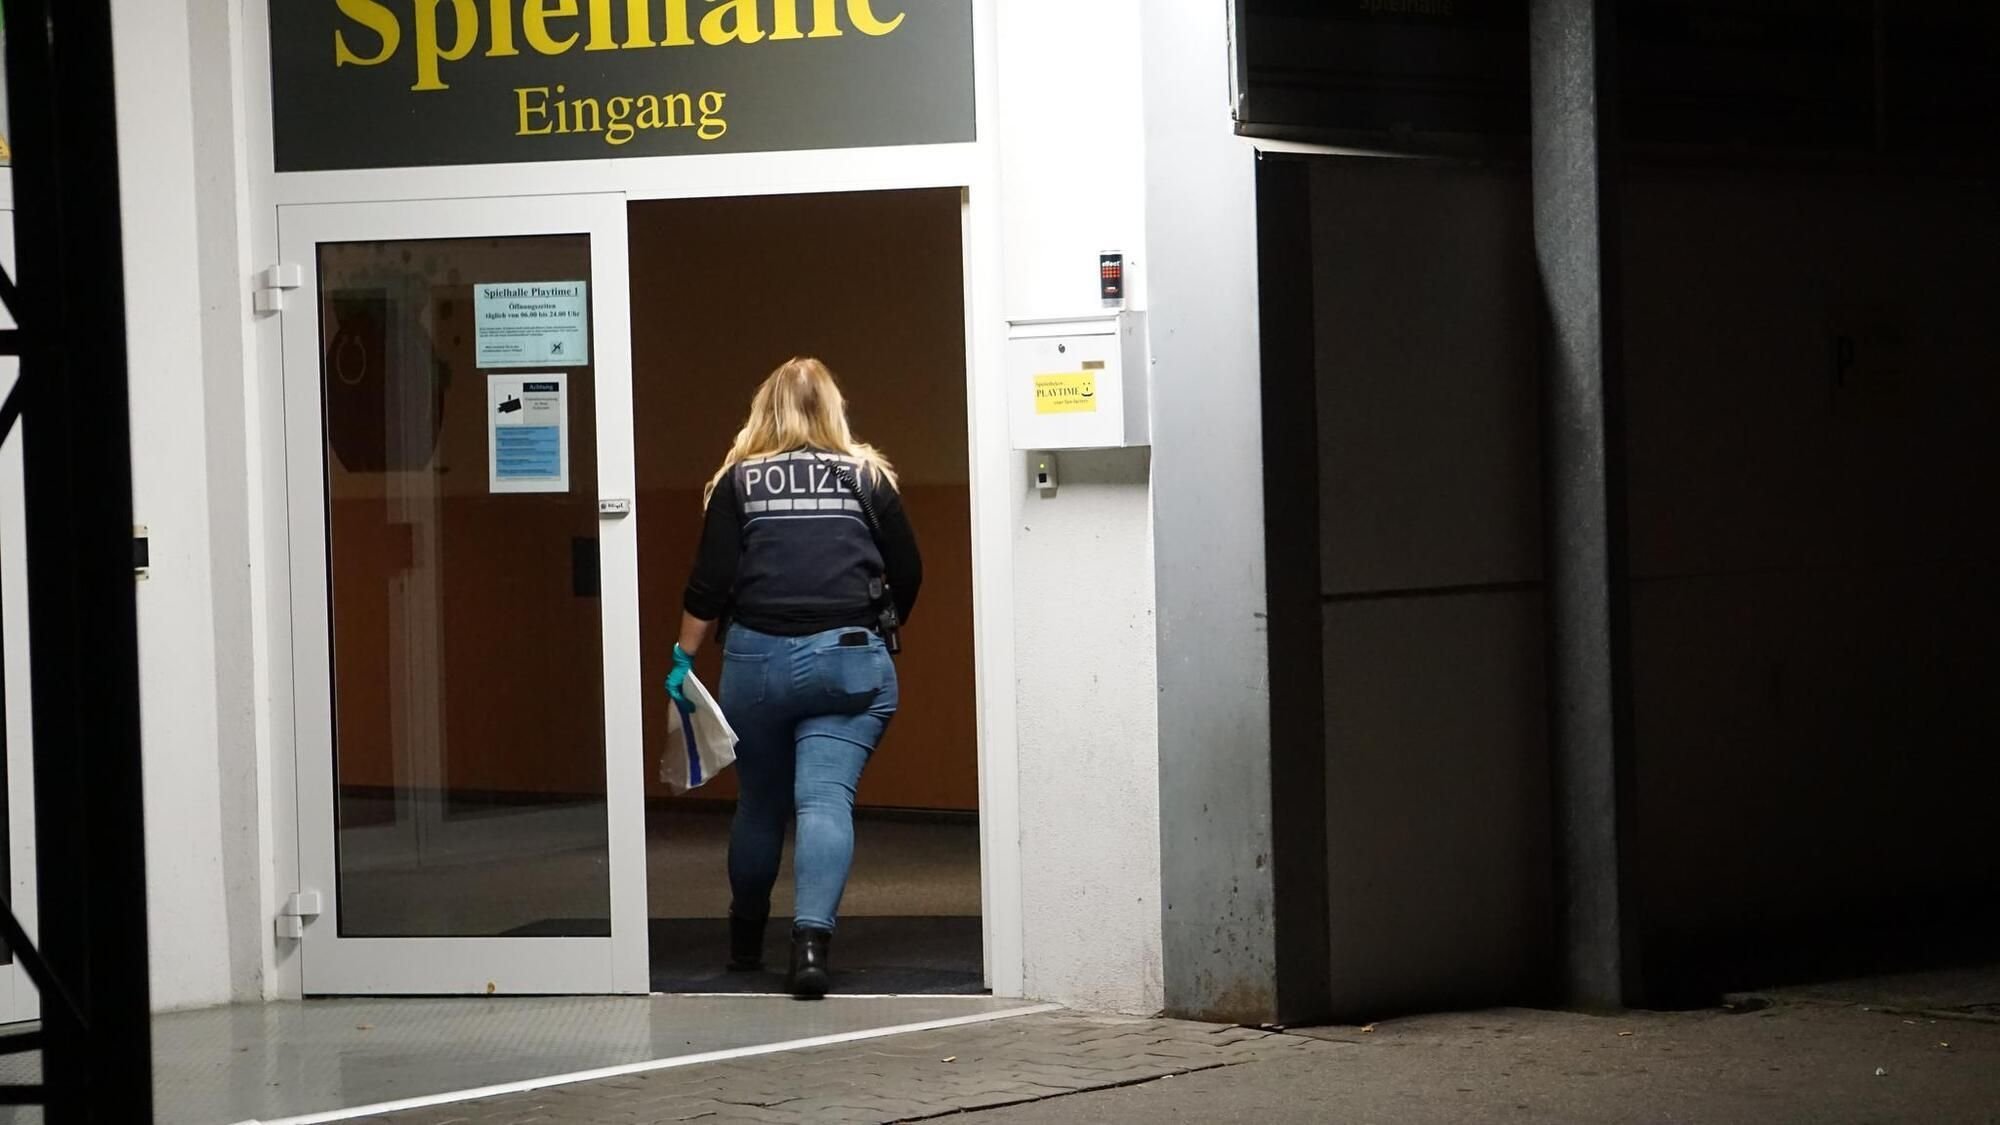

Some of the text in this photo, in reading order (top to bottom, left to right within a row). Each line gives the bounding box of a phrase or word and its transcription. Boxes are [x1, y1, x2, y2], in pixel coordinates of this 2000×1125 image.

[515, 86, 727, 145] Eingang
[484, 288, 529, 299] Spielhalle
[531, 287, 571, 298] Playtime
[485, 312, 506, 320] täglich
[568, 309, 580, 317] Uhr
[1036, 387, 1079, 398] PLAYTIME
[745, 464, 861, 496] POLIZEI
